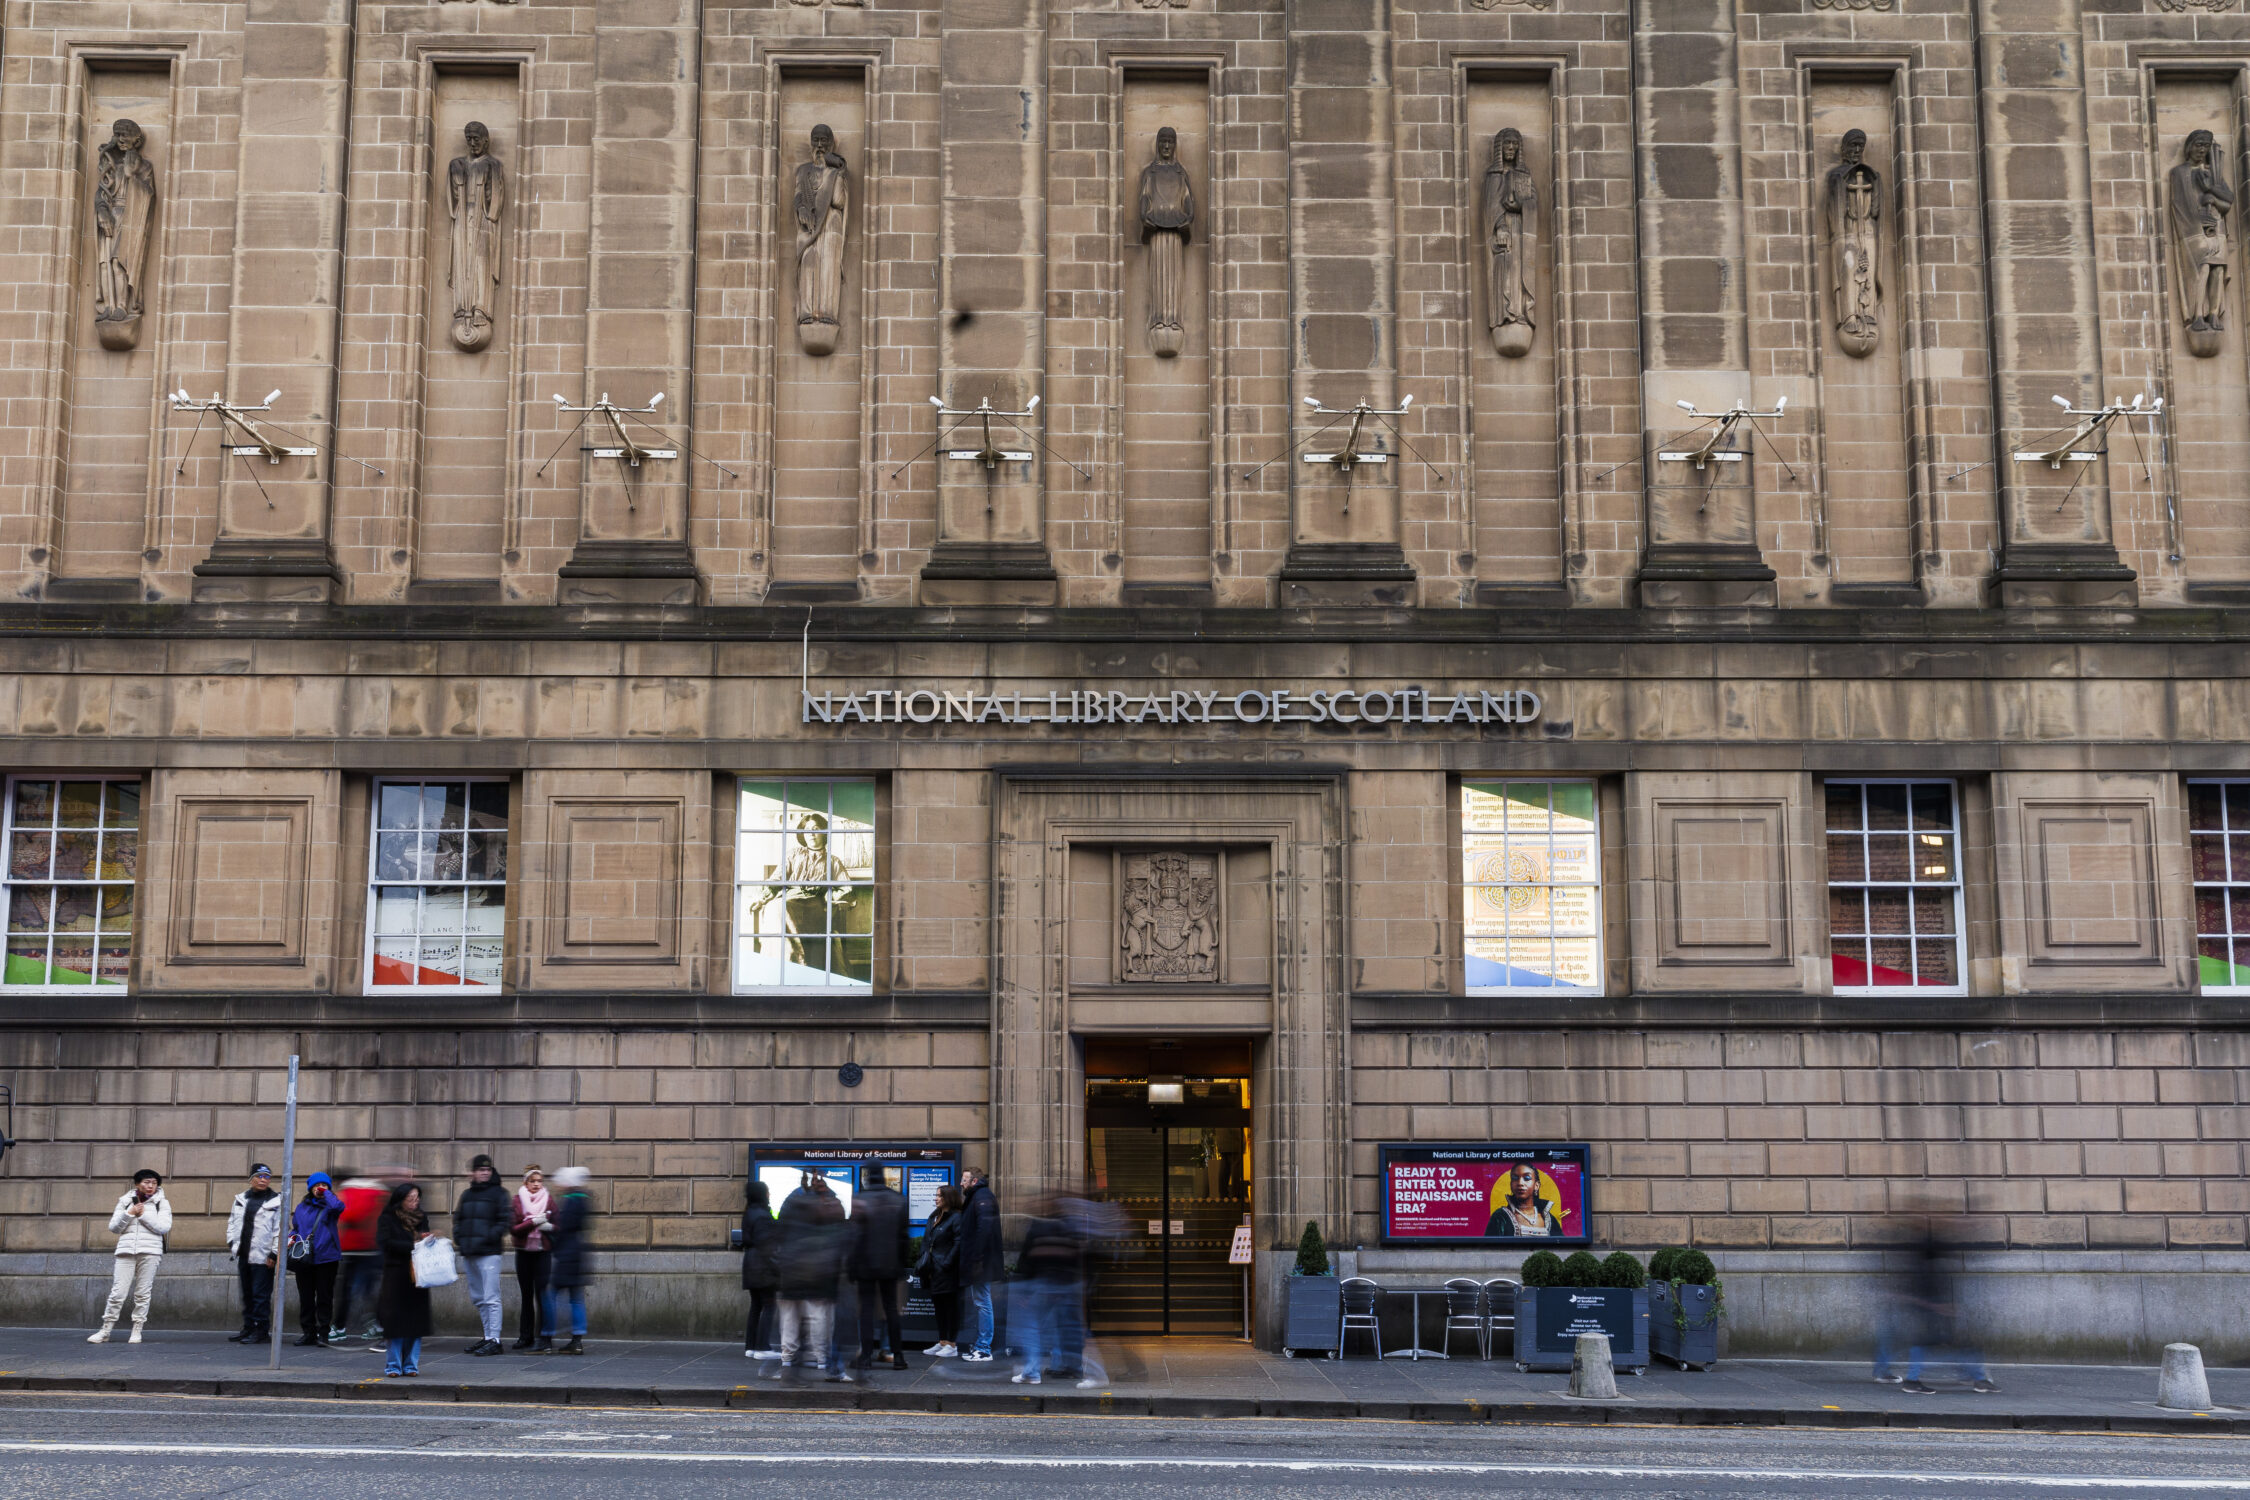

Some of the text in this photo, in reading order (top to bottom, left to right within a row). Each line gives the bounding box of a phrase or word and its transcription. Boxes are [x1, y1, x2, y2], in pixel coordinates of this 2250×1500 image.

[801, 690, 1542, 723] NATIONAL LIBRARY OF SCOTLAND
[804, 1150, 907, 1160] National Library of Scotland
[1432, 1151, 1464, 1159] National
[1465, 1151, 1491, 1160] Library
[1492, 1151, 1501, 1159] of
[1394, 1167, 1457, 1178] READY TO
[1395, 1179, 1475, 1190] ENTER YOUR
[1395, 1191, 1484, 1202] RENAISSANCE
[1395, 1203, 1427, 1214] ERA?
